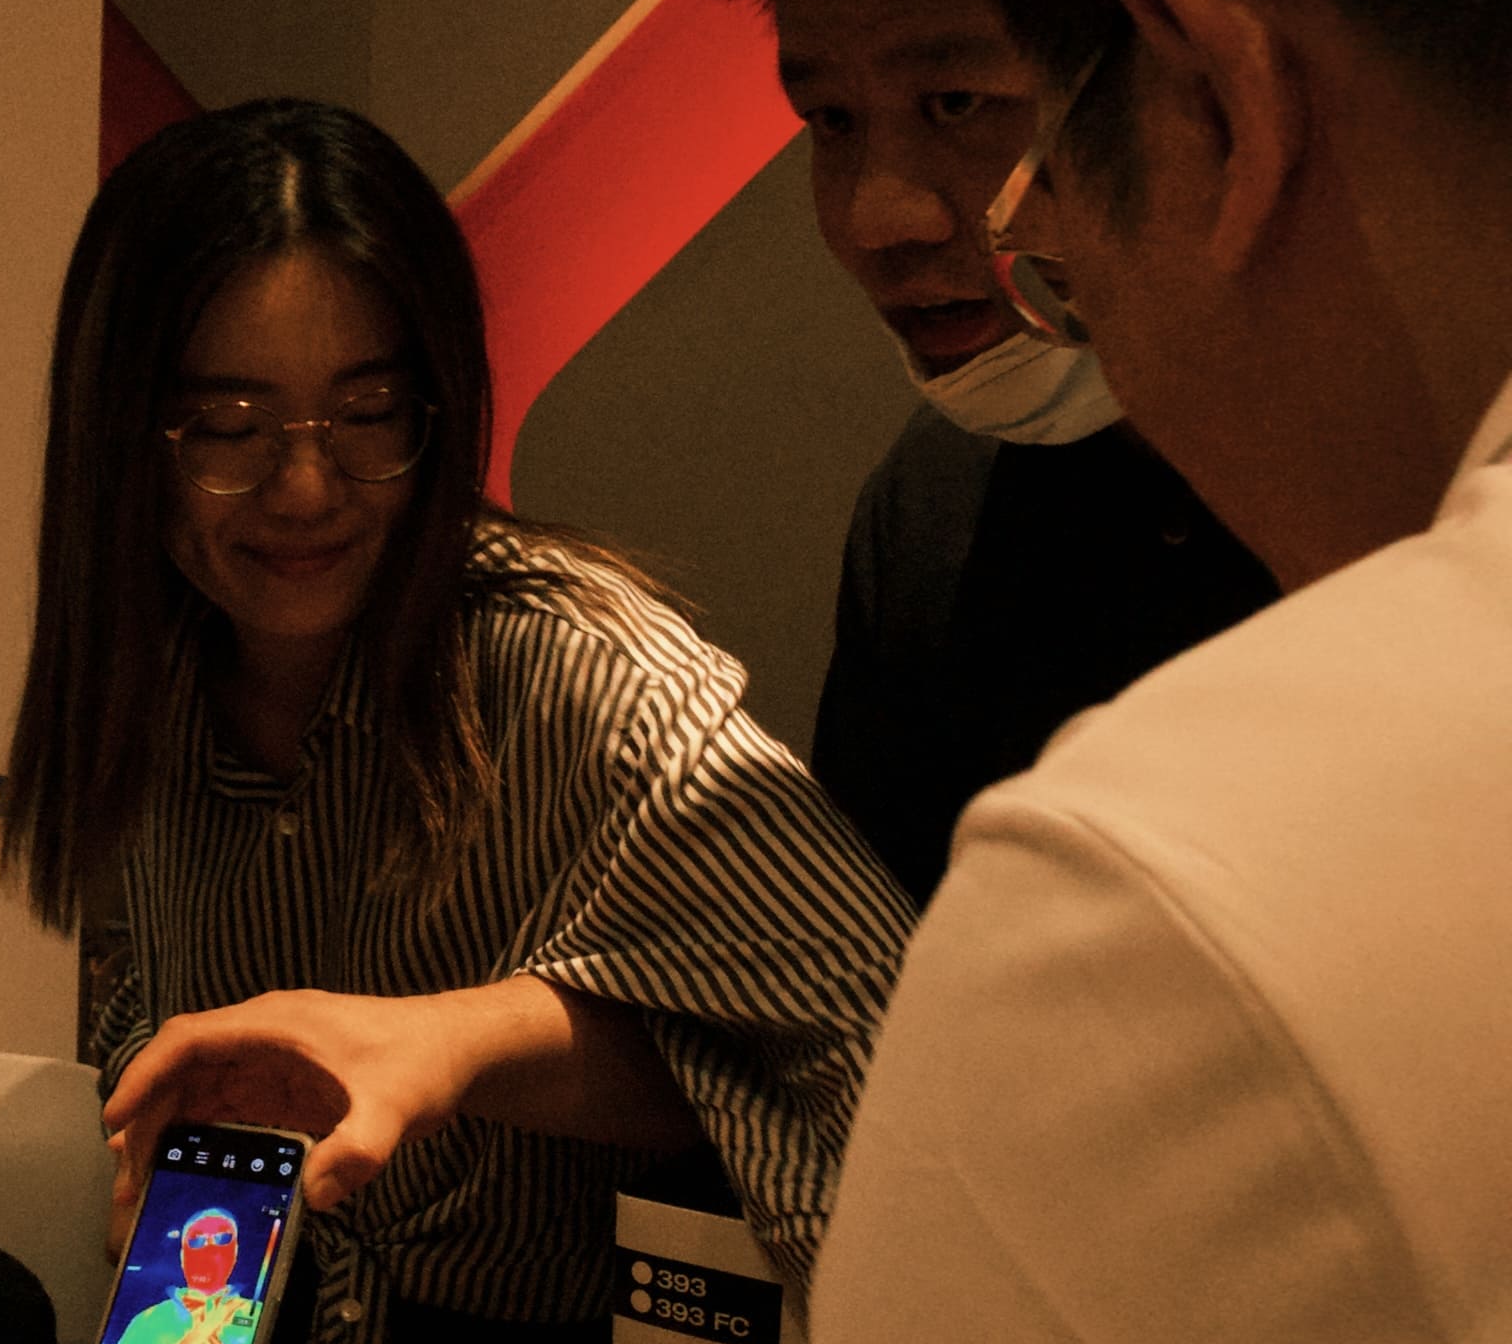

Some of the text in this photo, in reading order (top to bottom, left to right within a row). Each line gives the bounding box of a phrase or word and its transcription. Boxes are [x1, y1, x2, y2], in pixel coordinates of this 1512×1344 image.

[655, 1268, 707, 1298] 393
[655, 1297, 751, 1337] 393 FC
